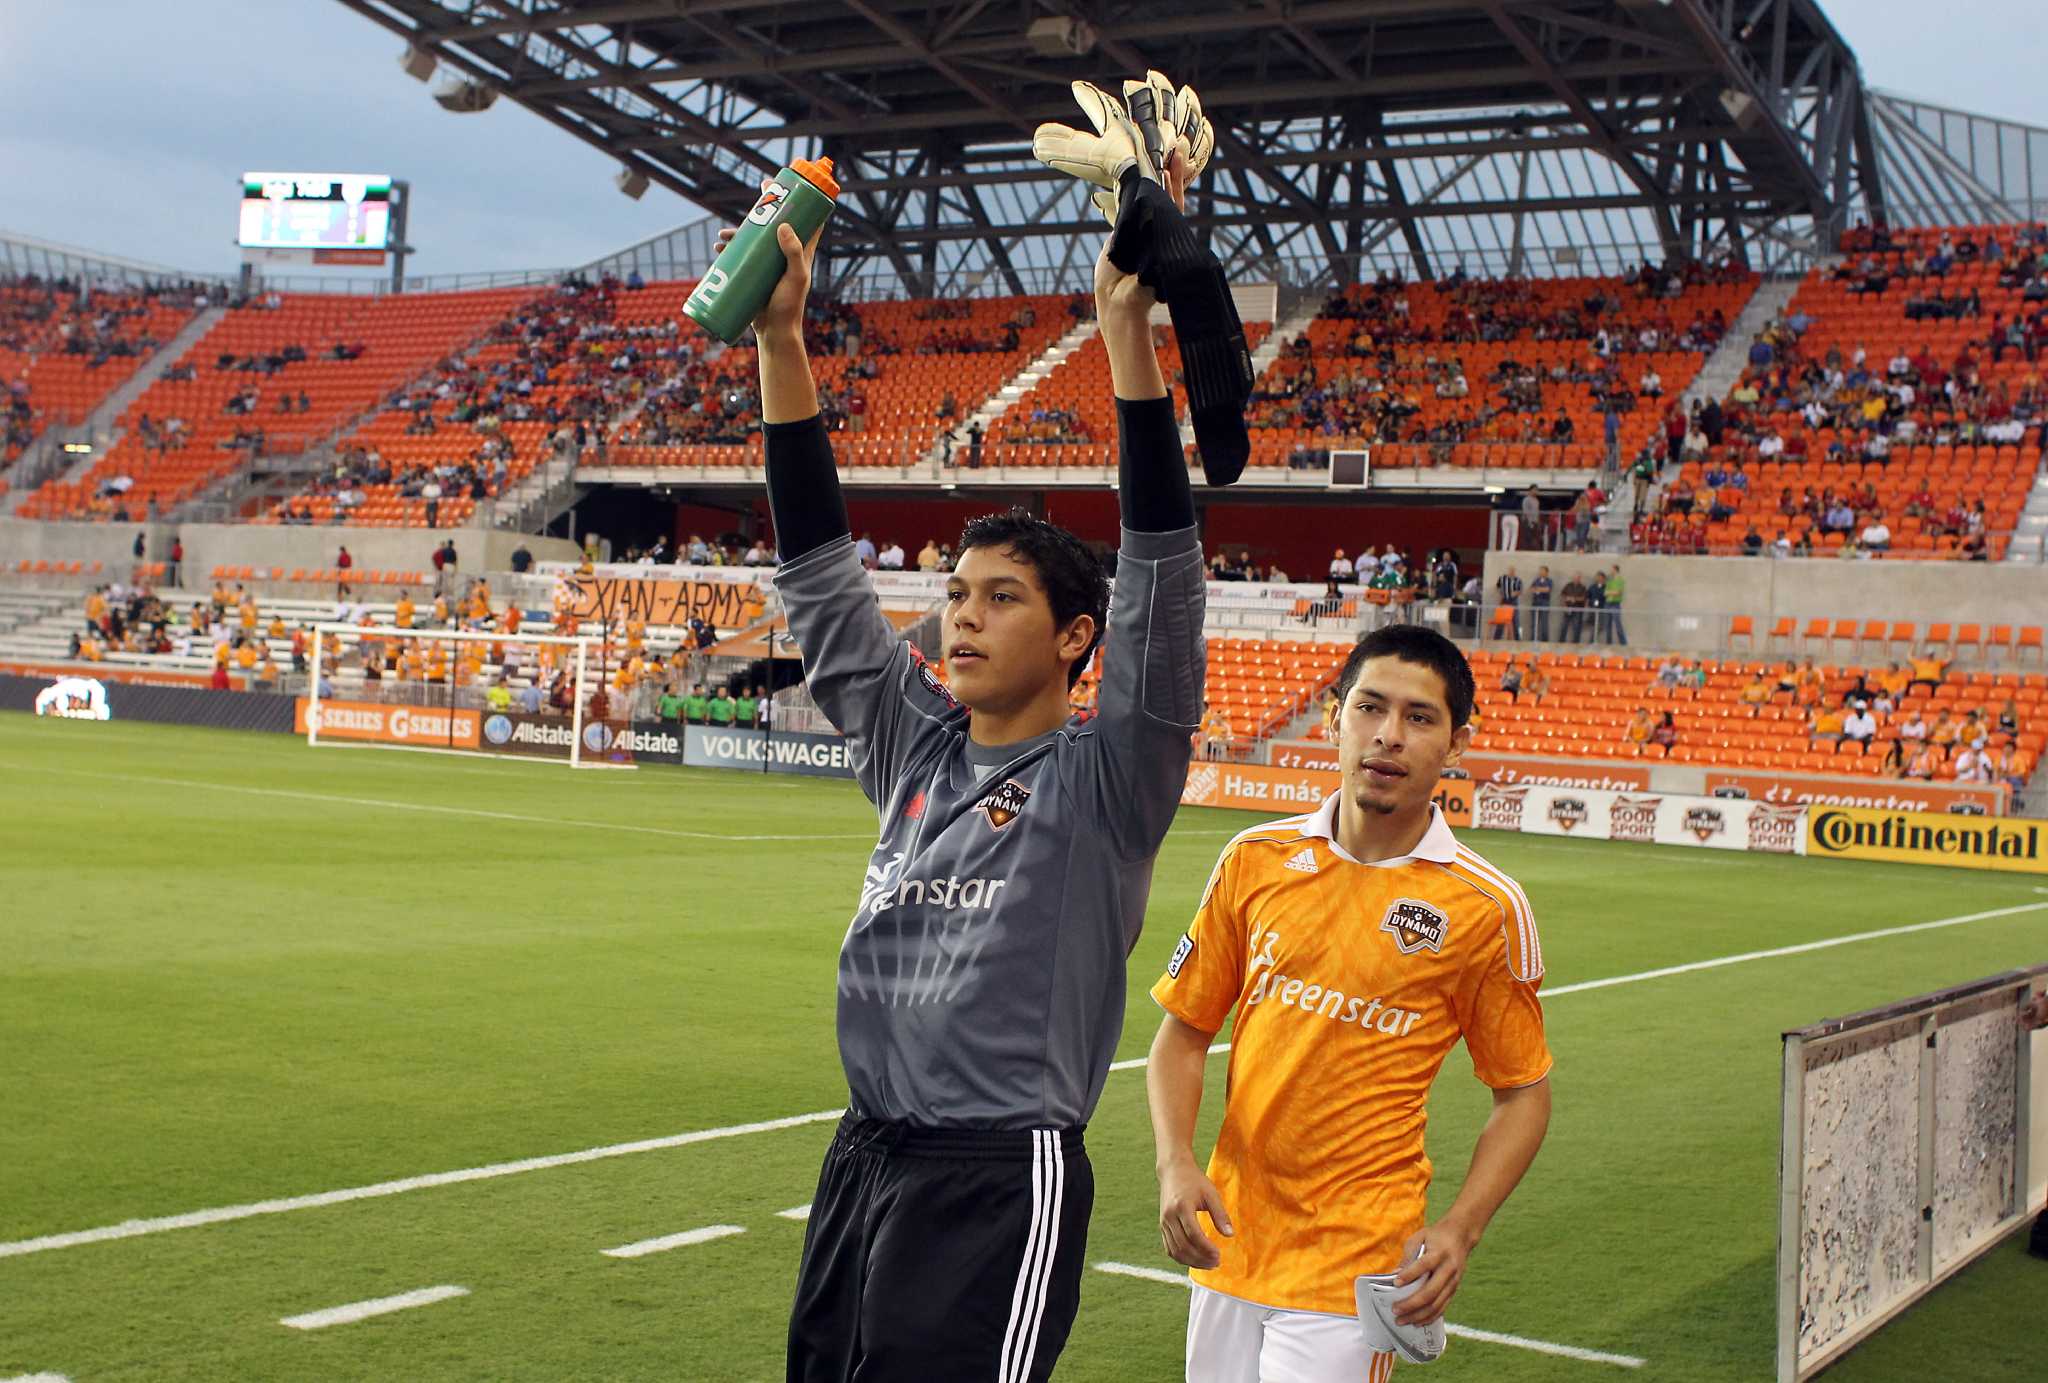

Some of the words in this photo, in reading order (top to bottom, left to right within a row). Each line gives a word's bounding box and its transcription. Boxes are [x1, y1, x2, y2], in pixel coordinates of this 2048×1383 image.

[669, 581, 753, 626] ARMY
[512, 722, 574, 746] Allstate
[612, 730, 678, 753] Allstate
[1225, 774, 1268, 799] Haz
[981, 794, 1021, 814] DYNAM
[1480, 797, 1523, 813] GOOD
[1480, 813, 1521, 825] SPORT
[1610, 807, 1656, 823] GOOD
[1610, 823, 1656, 836] SPORT
[1749, 819, 1796, 834] GOOD
[1813, 811, 2038, 859] Continental
[1284, 861, 1320, 873] adidas
[1390, 914, 1440, 942] DYNAMO
